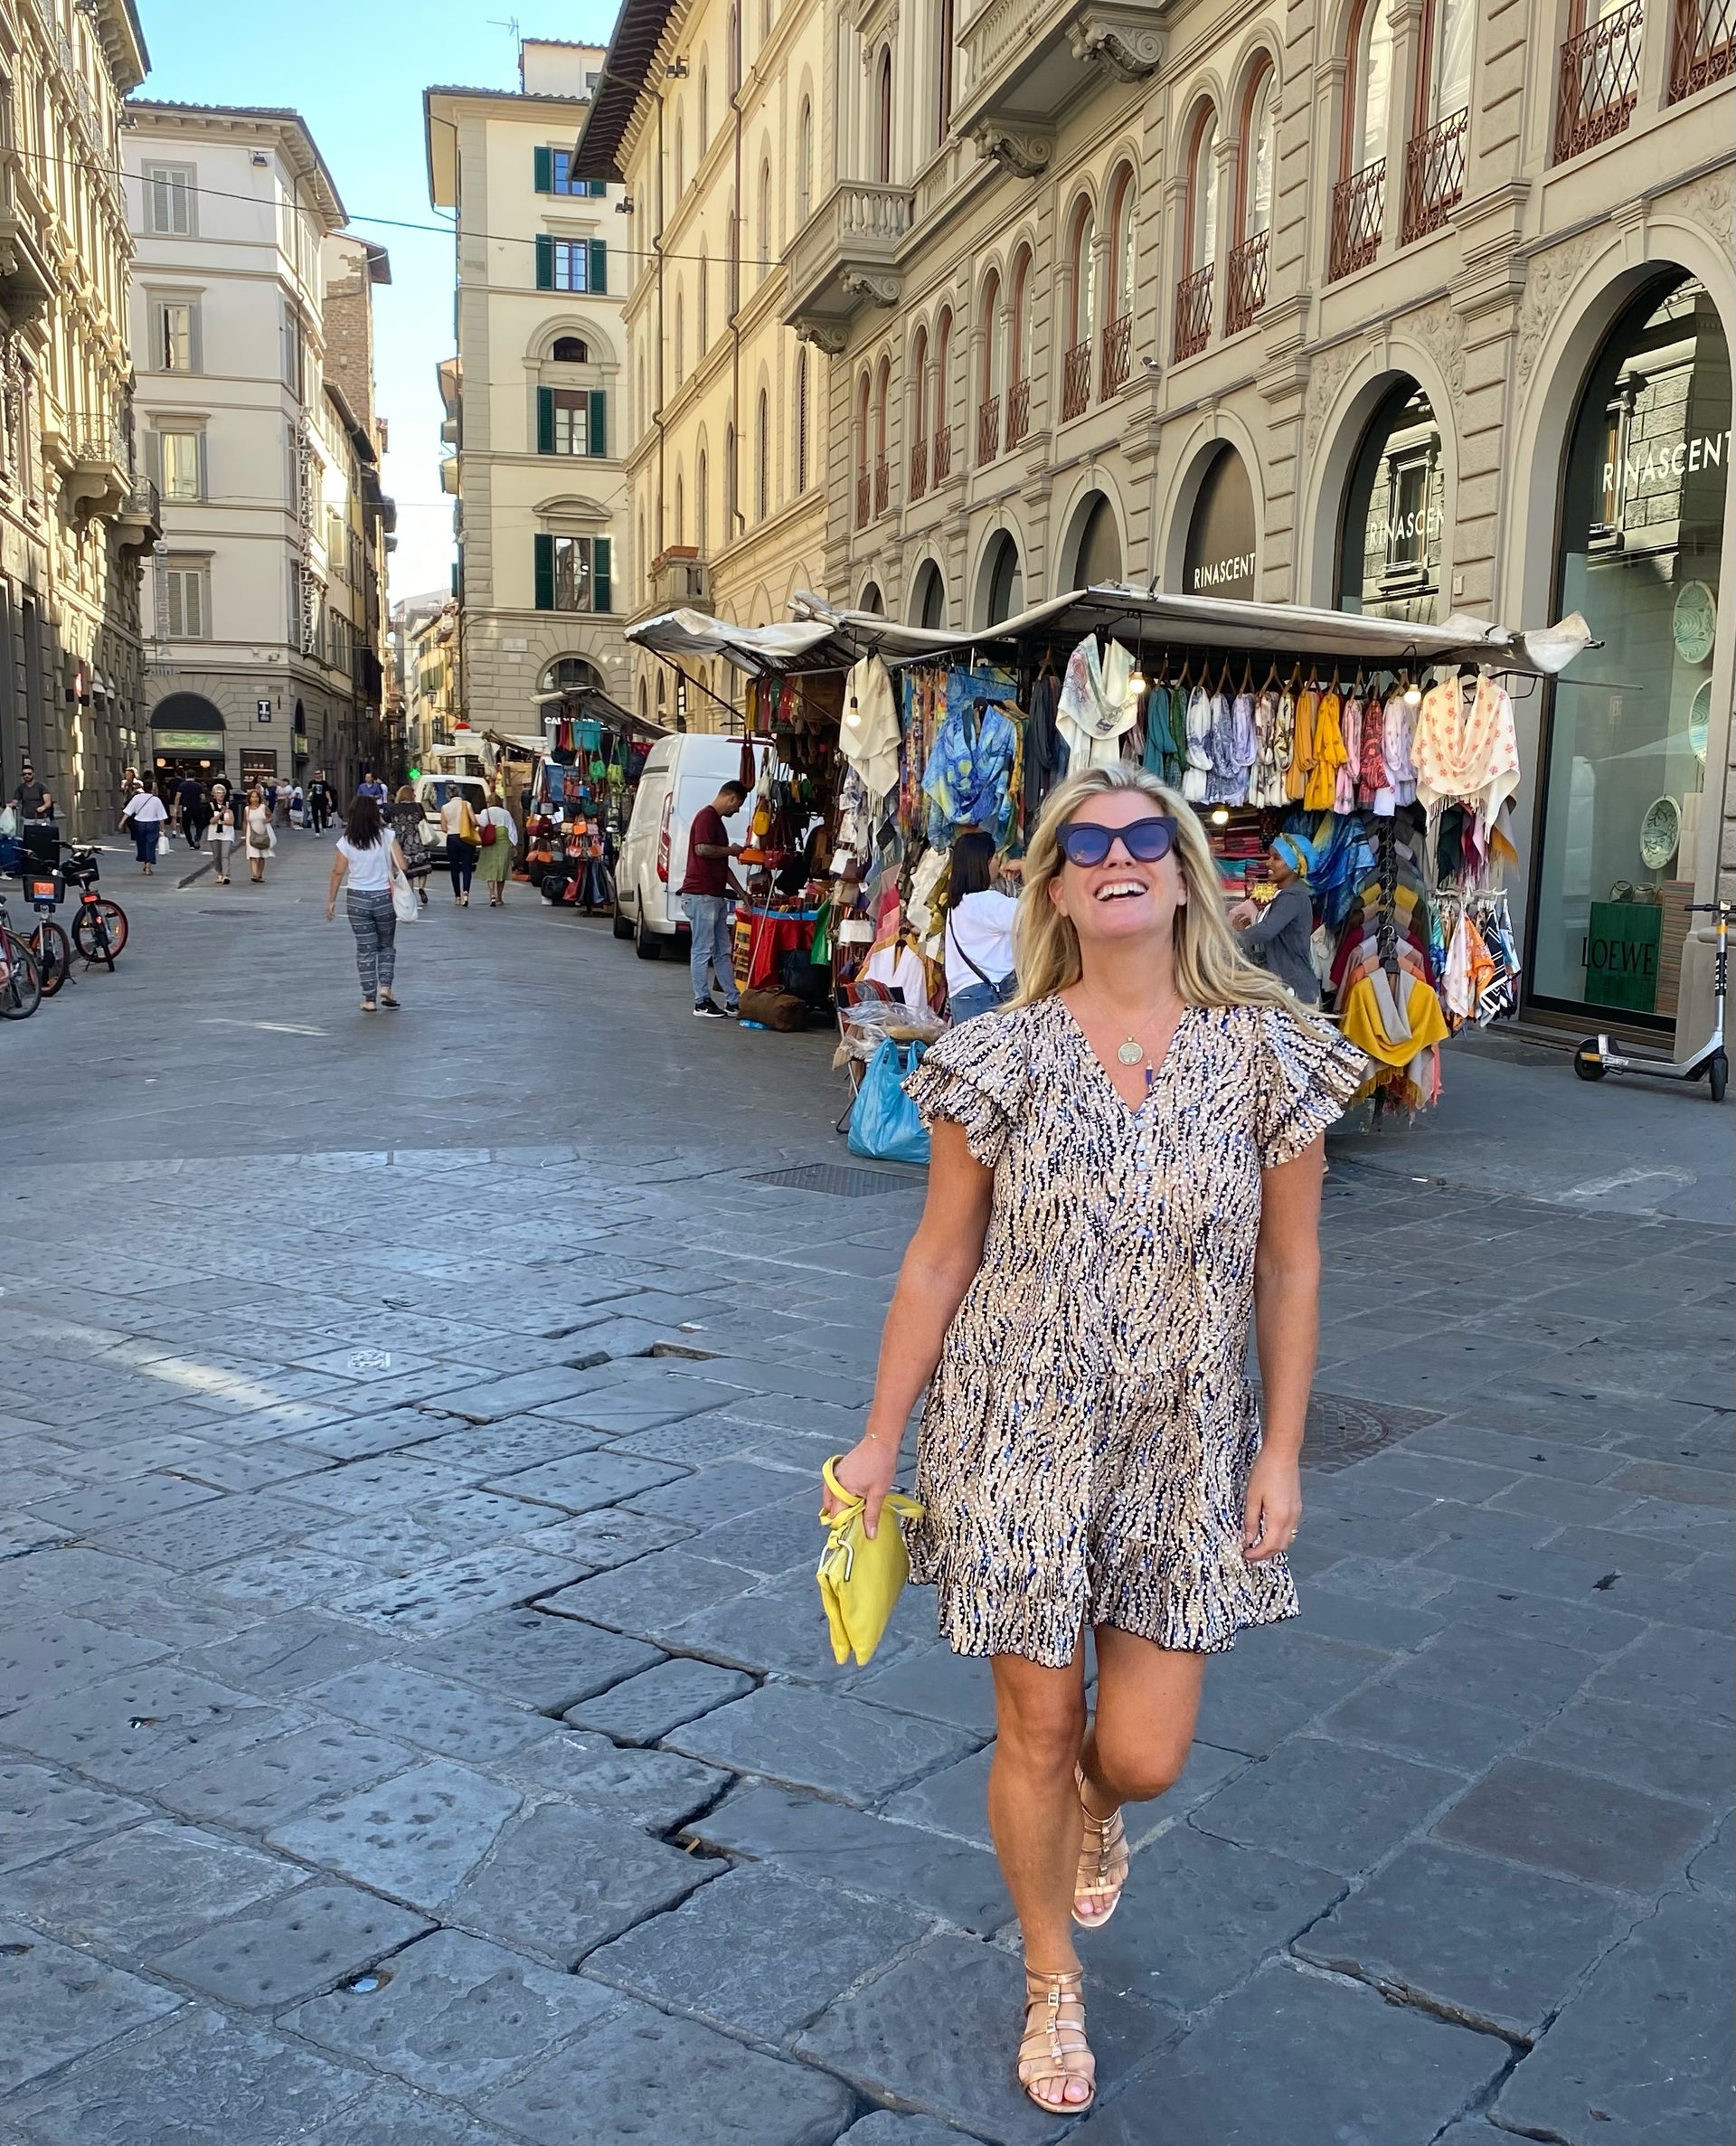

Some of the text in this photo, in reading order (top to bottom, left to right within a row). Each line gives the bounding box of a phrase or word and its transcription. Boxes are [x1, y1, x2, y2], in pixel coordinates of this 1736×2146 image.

[299, 406, 312, 475] HOTEL
[1194, 553, 1256, 590] RINASCENT
[1581, 937, 1656, 975] LOEWE
